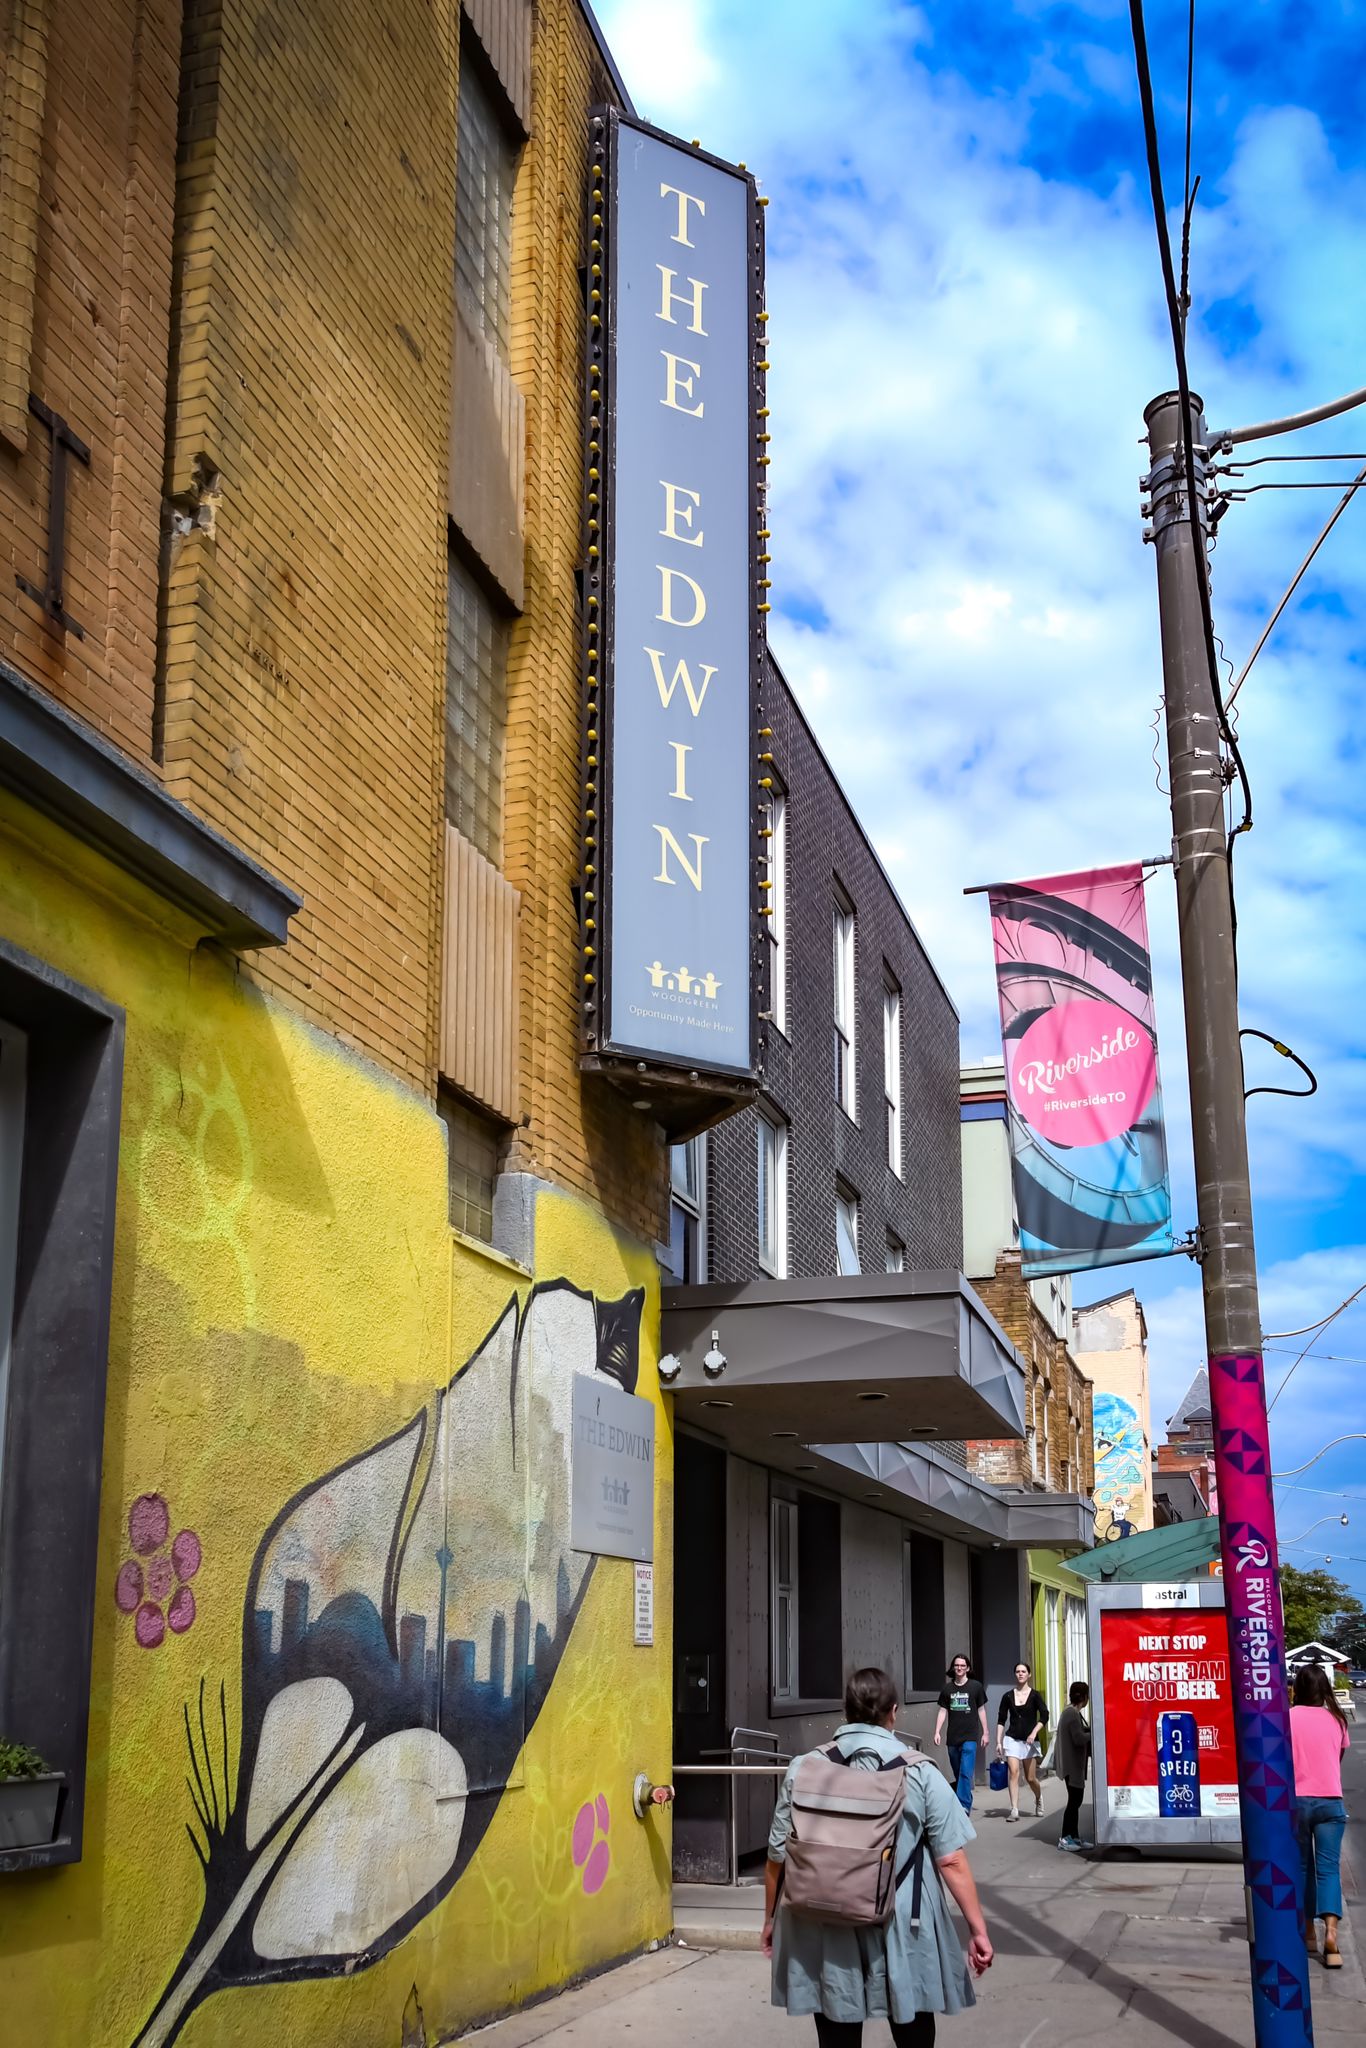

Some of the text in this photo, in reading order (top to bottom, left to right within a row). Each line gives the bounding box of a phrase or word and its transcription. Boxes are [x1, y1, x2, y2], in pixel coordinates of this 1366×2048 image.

[643, 182, 719, 893] THE EDWIN
[651, 991, 719, 1011] WOODGREEN
[629, 1004, 735, 1034] Opportunity Made Here
[1018, 1027, 1140, 1095] Riverside
[1044, 1091, 1126, 1112] #RiversideTO
[579, 1415, 650, 1462] THE EDWIN
[636, 1570, 652, 1580] NOTICE
[1155, 1589, 1187, 1600] astral
[1265, 1578, 1274, 1630] WELCOME TO
[1138, 1635, 1207, 1650] NEXT STOP
[1246, 1577, 1272, 1701] RIVERSIDE
[1240, 1618, 1252, 1701] TORONTO
[1172, 1729, 1183, 1754] 3
[1160, 1760, 1197, 1777] SPEED
